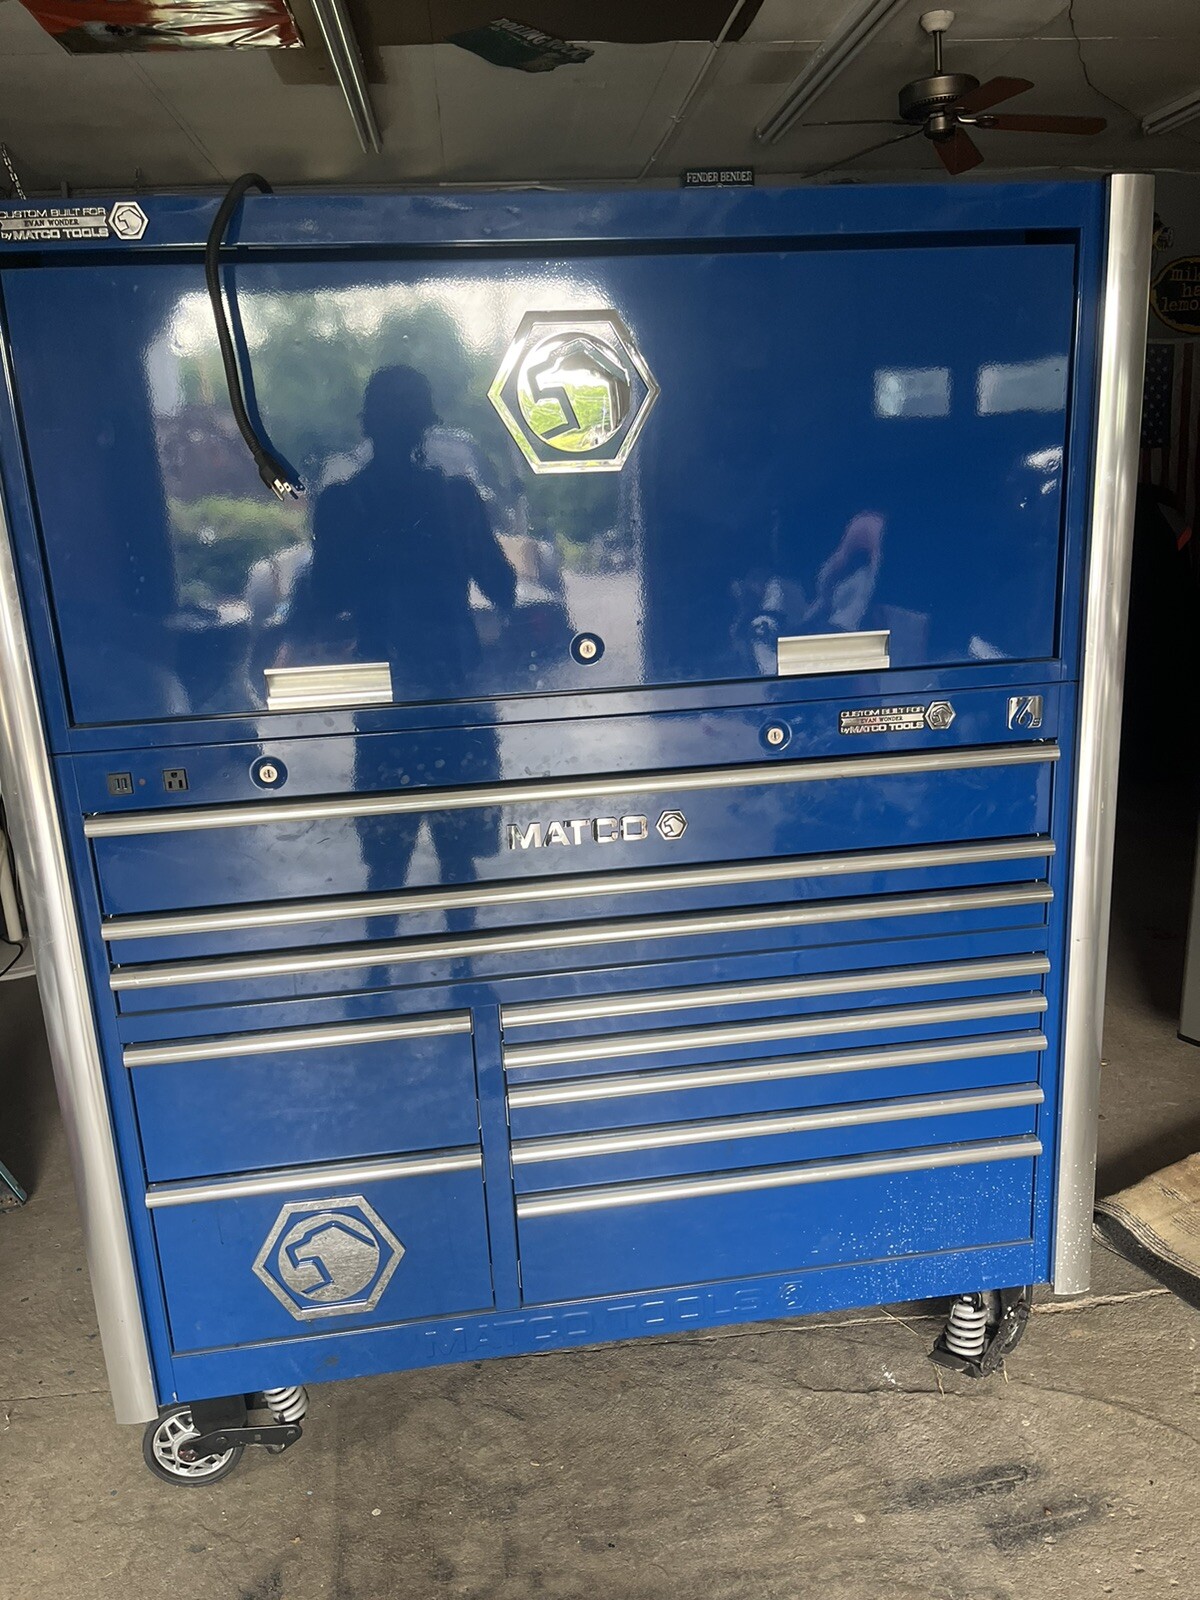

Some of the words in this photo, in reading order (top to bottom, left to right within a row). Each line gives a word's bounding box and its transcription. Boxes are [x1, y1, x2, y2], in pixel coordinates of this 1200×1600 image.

[686, 171, 719, 183] FENDER
[720, 170, 753, 182] BENDER
[0, 208, 48, 219] CUSTOM
[50, 207, 80, 217] BUILT
[82, 206, 107, 216] FOR
[24, 219, 45, 228] EVAN
[48, 218, 80, 227] WONDER
[1, 231, 13, 240] by
[13, 228, 61, 240] MATCO
[62, 227, 109, 239] TOOLS
[1160, 296, 1200, 313] lemo
[840, 709, 880, 718] CUSTOM
[881, 707, 905, 715] BUILT
[850, 724, 888, 734] MATCO
[888, 721, 925, 731] TOOLS
[506, 813, 649, 850] MATCO
[425, 1311, 594, 1359] MATCO
[606, 1288, 763, 1332] TOOLS
